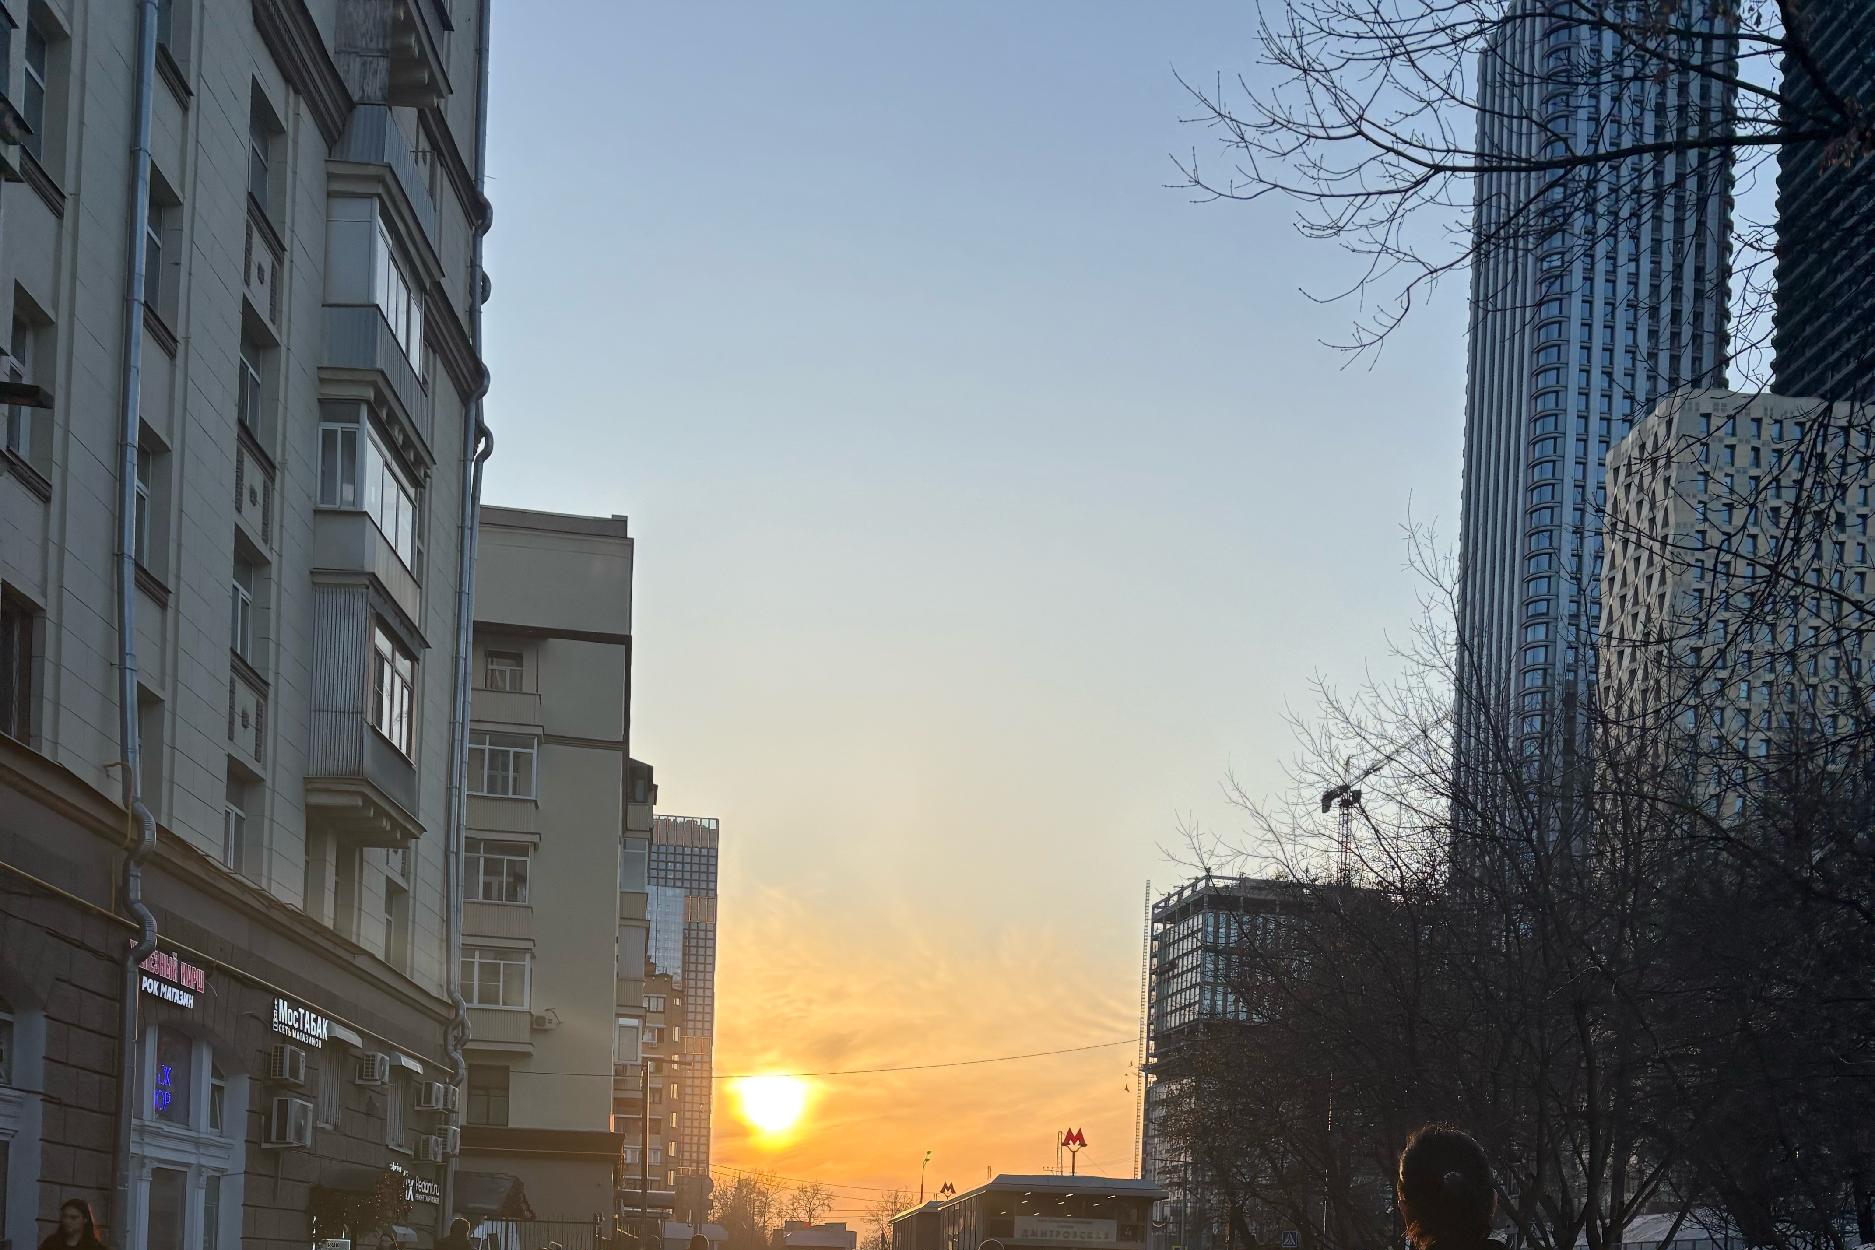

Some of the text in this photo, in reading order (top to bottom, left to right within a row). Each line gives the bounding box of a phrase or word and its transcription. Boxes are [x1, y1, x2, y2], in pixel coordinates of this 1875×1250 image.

[141, 974, 194, 1009] РОК МАГАЗИН
[278, 1023, 322, 1049] СЕТЬ МАГАЗИНОВ
